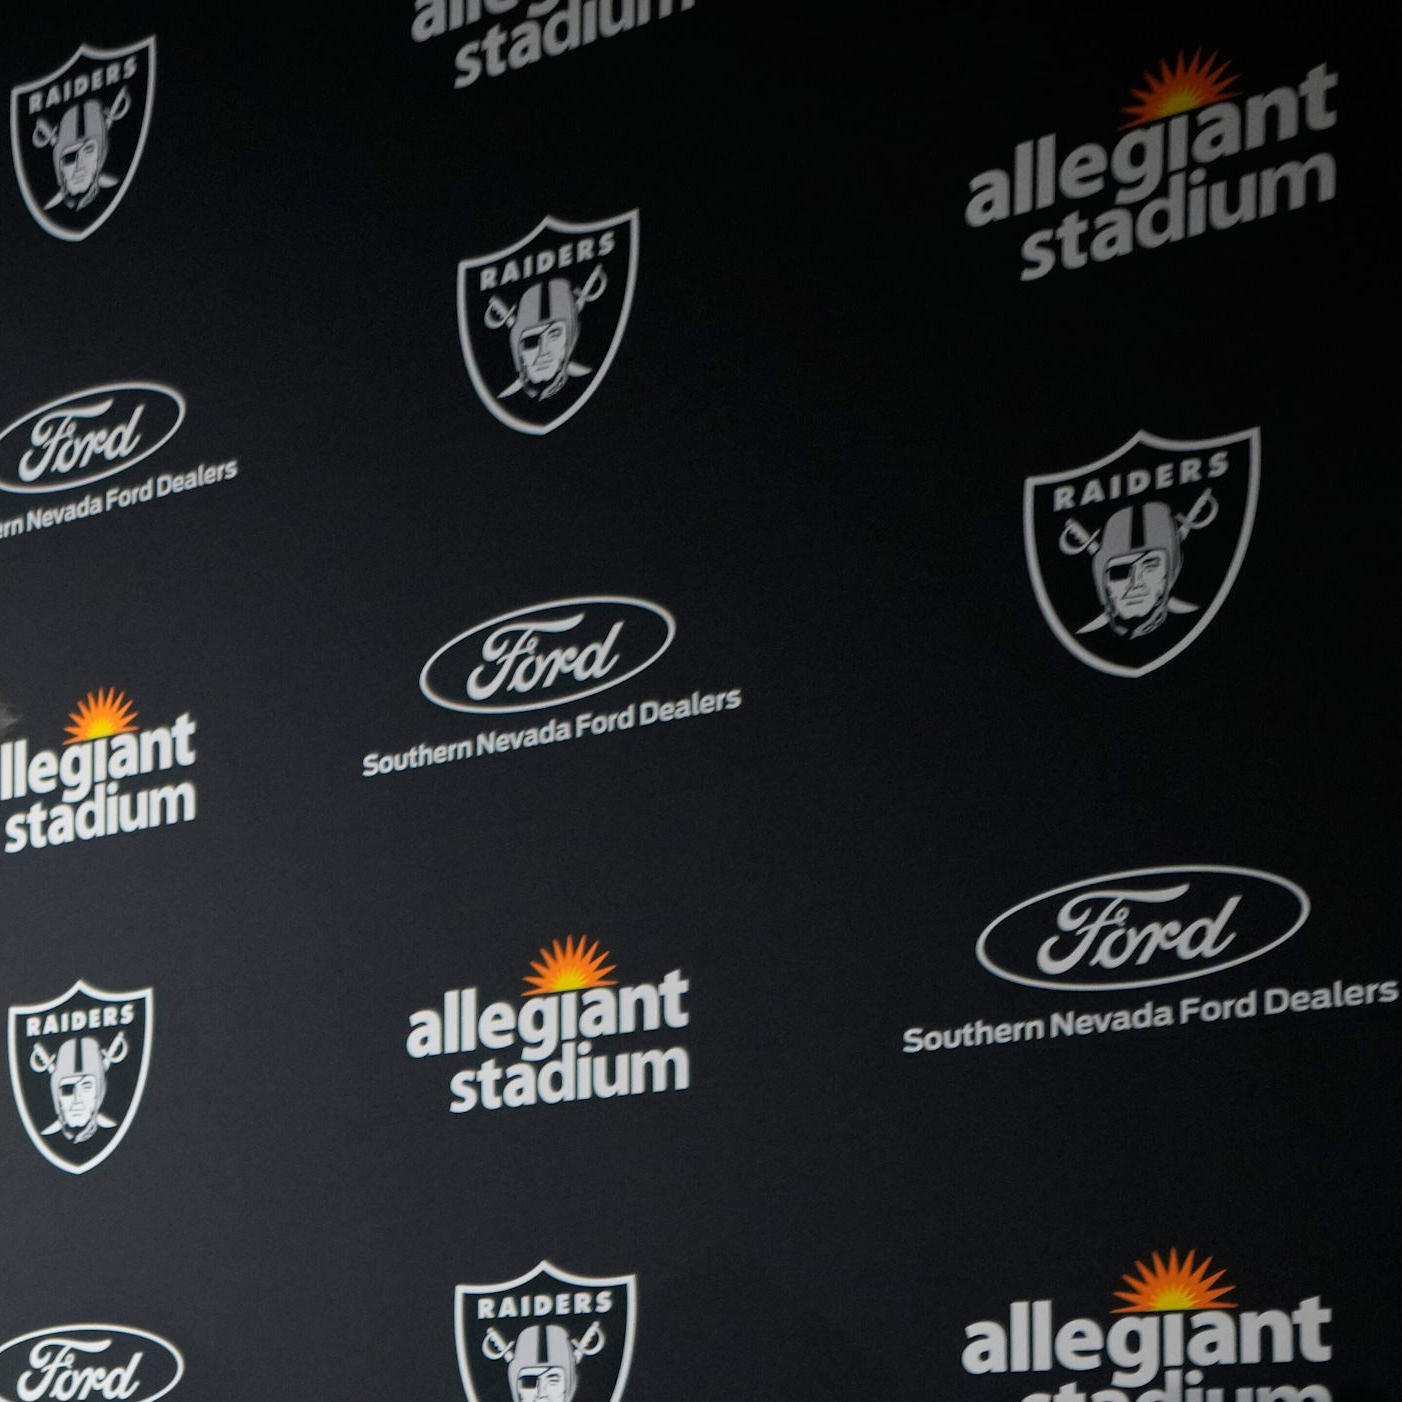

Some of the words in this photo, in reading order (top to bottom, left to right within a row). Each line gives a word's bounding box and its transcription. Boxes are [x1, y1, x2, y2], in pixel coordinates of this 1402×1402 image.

[29, 56, 138, 115] RAIDERS
[964, 61, 1339, 229] allegiant
[1019, 150, 1338, 283] stadium
[480, 230, 617, 292] RAIDERS
[17, 397, 146, 484] Ford
[26, 494, 103, 532] Nevada
[104, 478, 154, 513] Ford
[156, 458, 239, 500] Dealers
[1053, 450, 1230, 512] RAIDERS
[466, 611, 626, 702] Ford
[361, 738, 473, 778] Southern
[475, 718, 572, 758] Nevada
[574, 702, 635, 739] Ford
[639, 686, 743, 728] Dealers
[4, 780, 197, 854] stadium
[1036, 881, 1243, 976] Ford
[26, 1002, 135, 1038] RAIDERS
[405, 967, 691, 1062] allegiant
[901, 1019, 1045, 1055] Southern
[1049, 1000, 1175, 1039] Nevada
[1178, 988, 1258, 1026] Ford
[1262, 979, 1400, 1015] Dealers
[448, 1040, 691, 1115] stadium
[477, 1290, 613, 1320] RAIDERS
[961, 1295, 1334, 1389] allegiant
[16, 1336, 146, 1402] Ford
